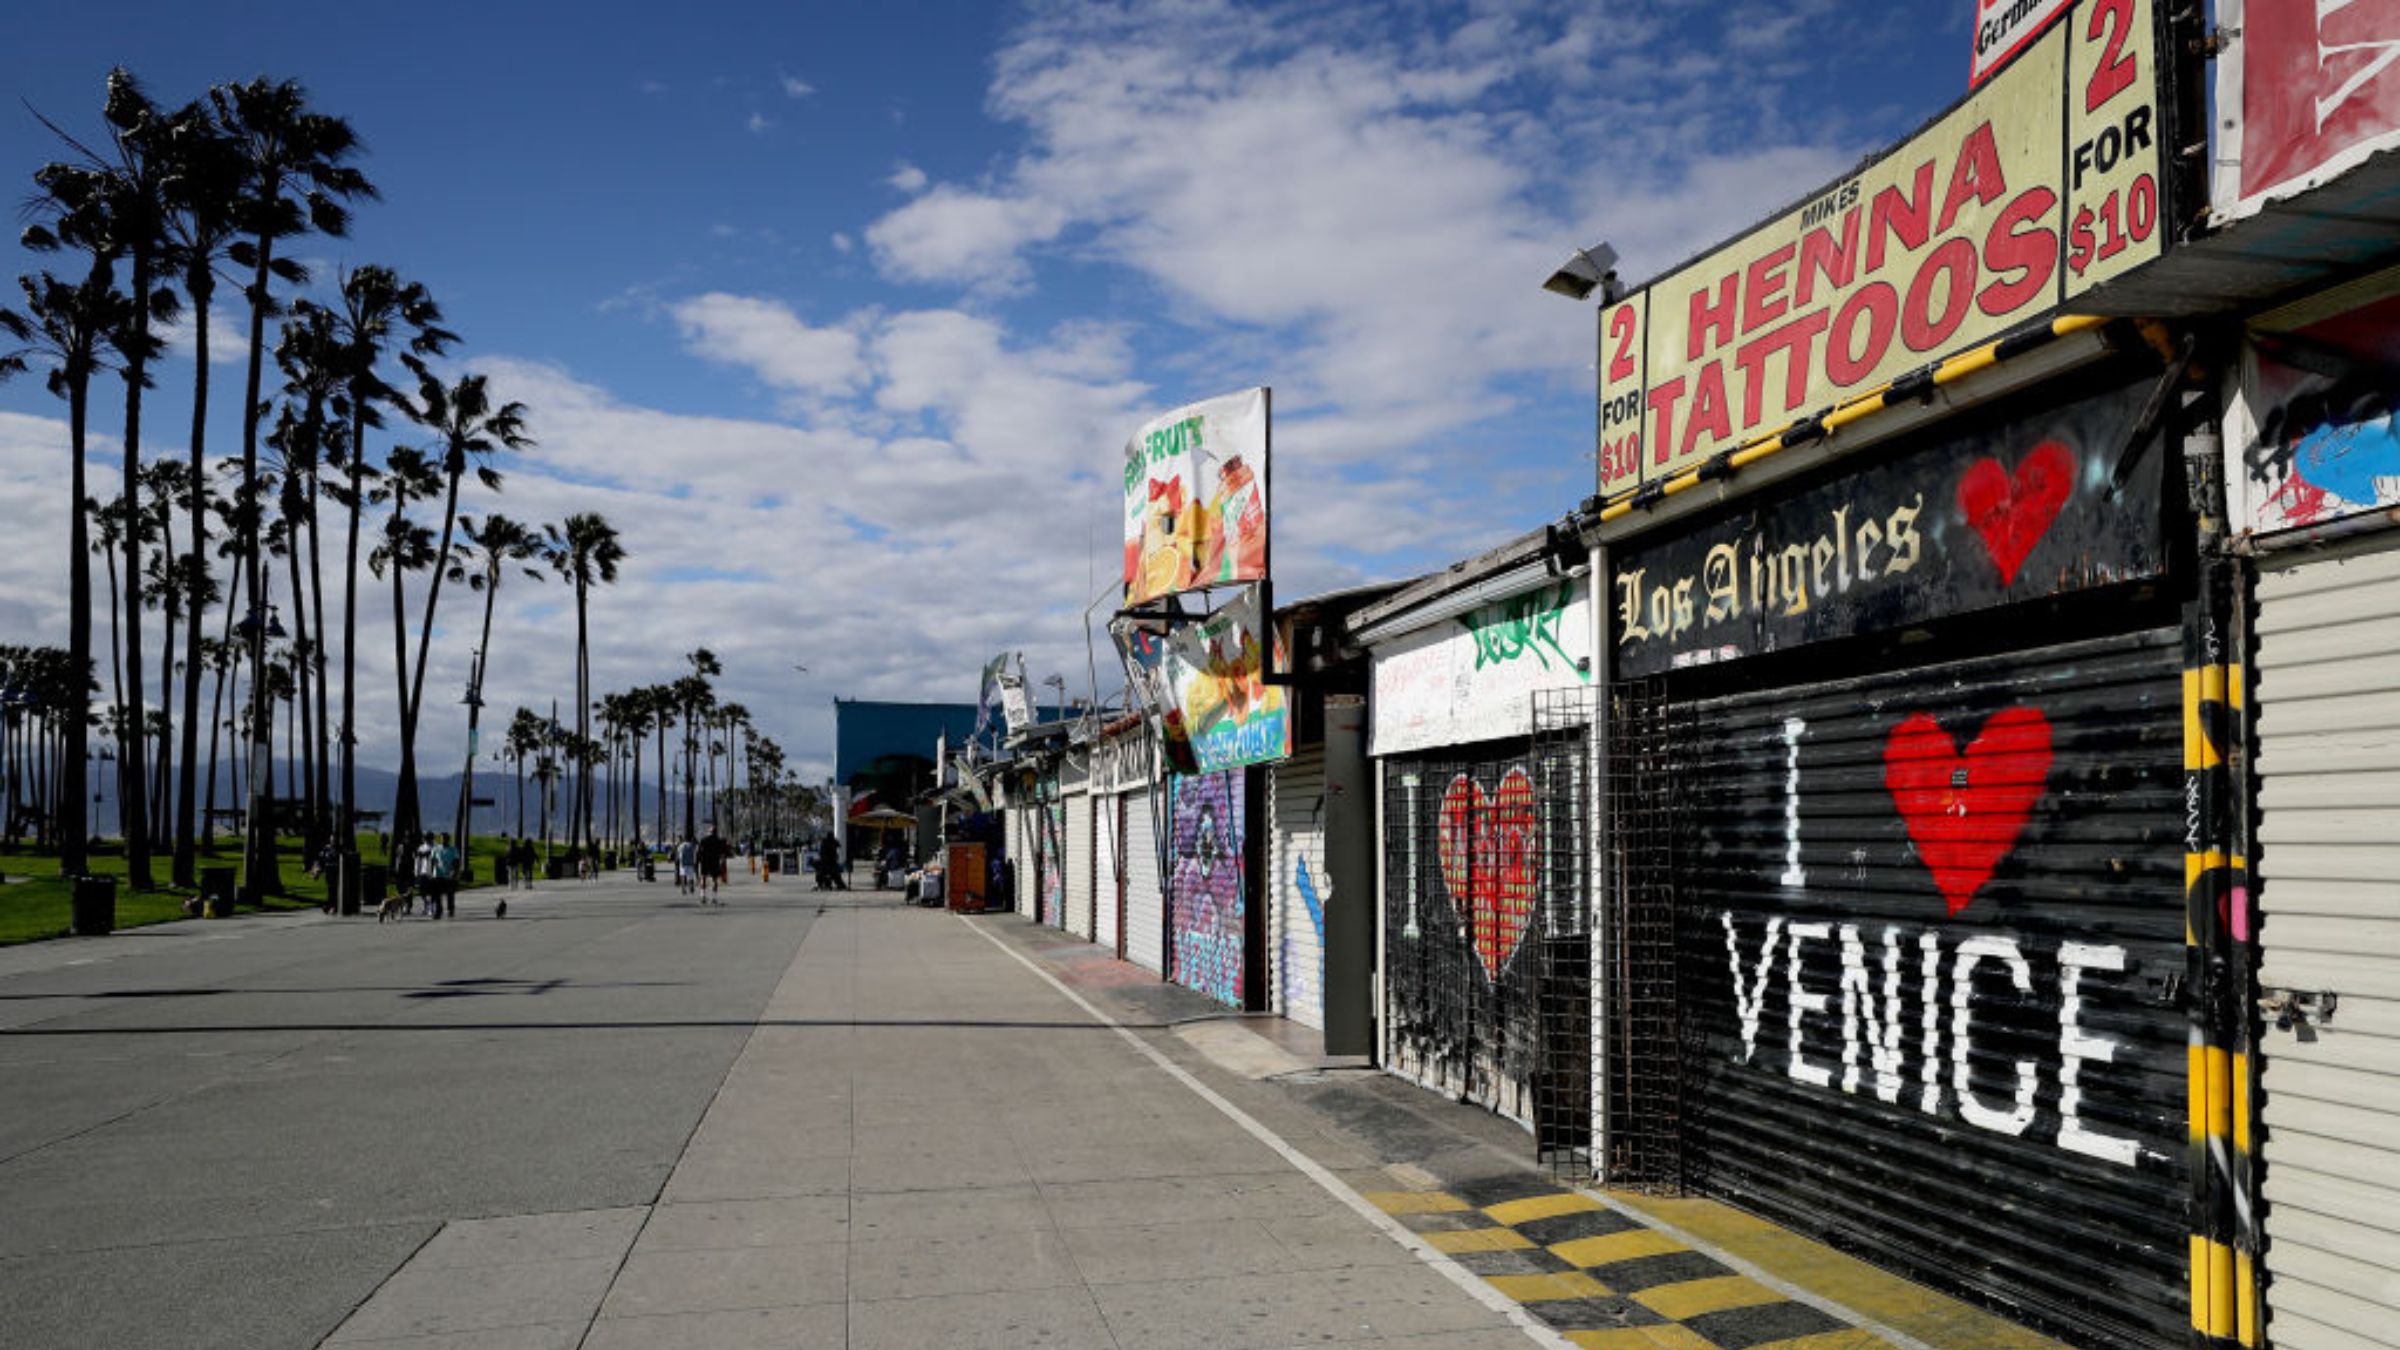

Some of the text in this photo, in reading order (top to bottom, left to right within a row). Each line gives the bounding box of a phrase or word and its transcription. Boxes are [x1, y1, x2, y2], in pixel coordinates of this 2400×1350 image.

[2086, 0, 2136, 115] 2
[2073, 104, 2152, 190] FOR
[1687, 119, 2006, 362] HENNA
[1801, 180, 1860, 231] MIKES
[2068, 172, 2157, 277] $10
[1610, 304, 1636, 384] 2
[1646, 185, 2058, 465] TATTOOS
[1600, 431, 1639, 487] $10
[1602, 389, 1641, 430] FOR
[1616, 566, 1696, 646] Los
[1703, 491, 1924, 630] Angeles
[1721, 910, 2142, 1167] VENICE
